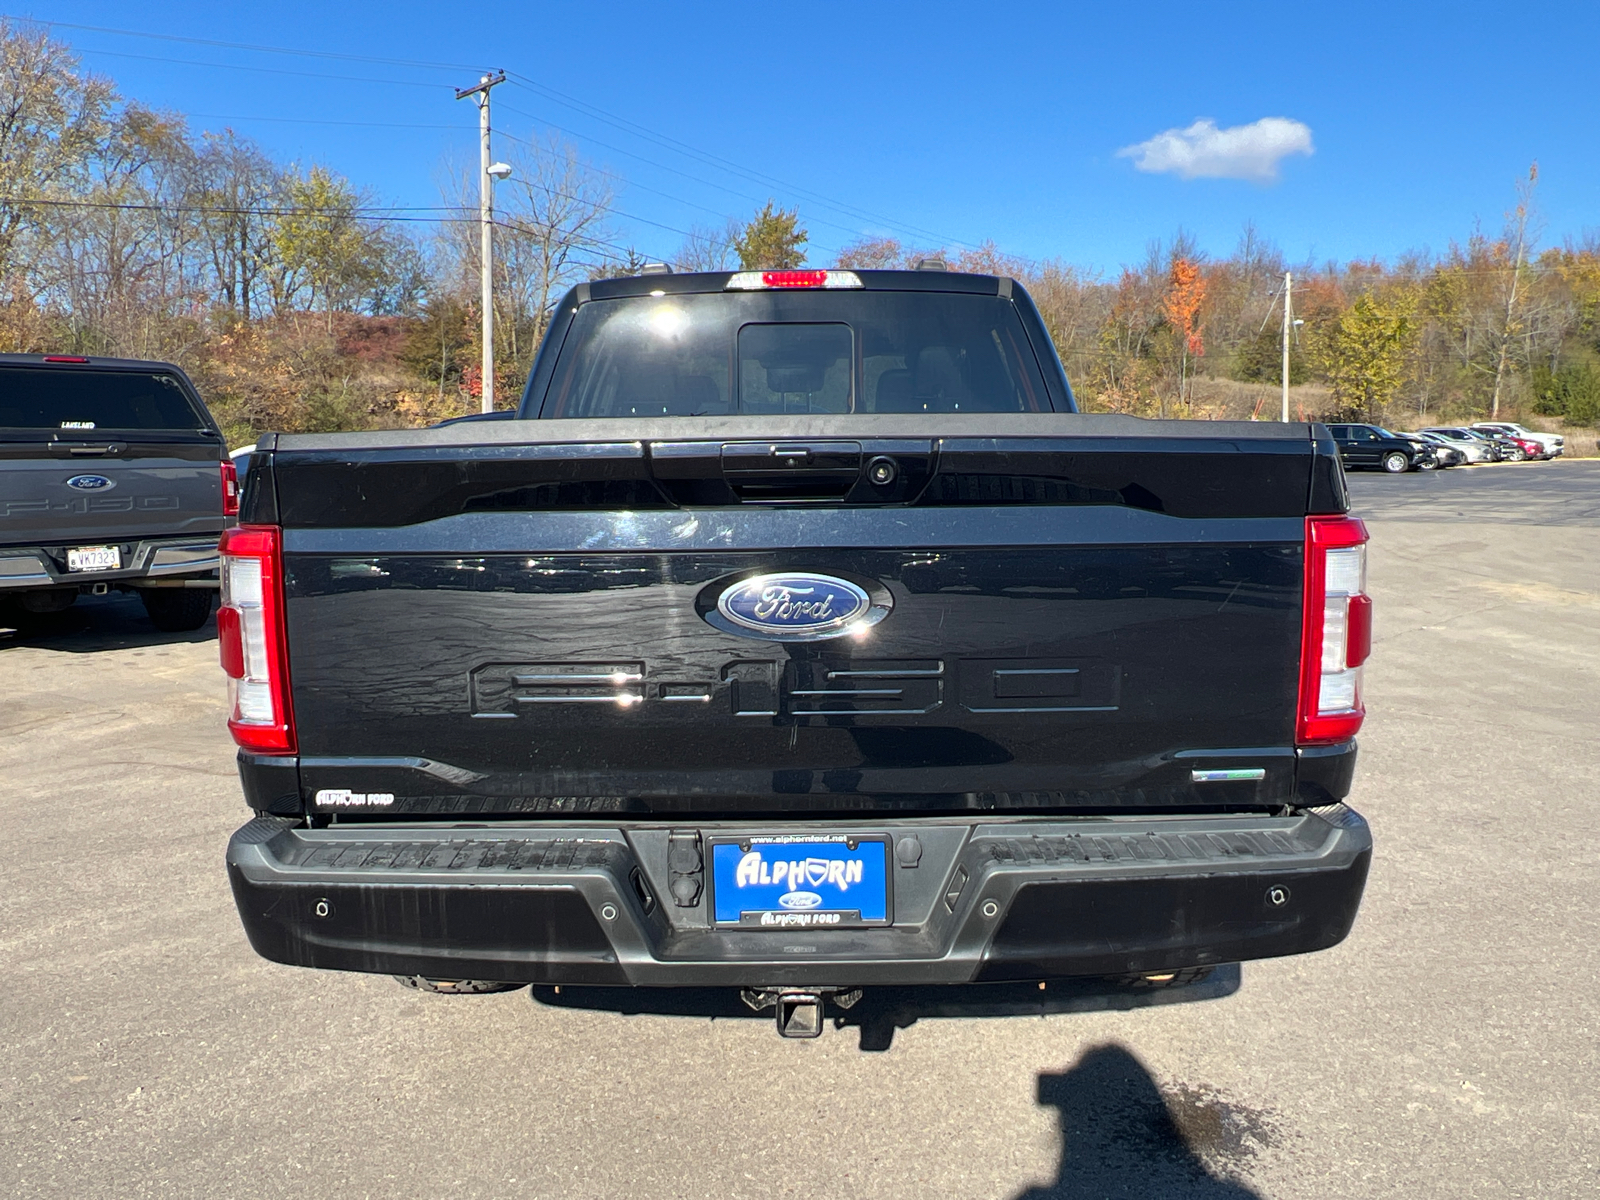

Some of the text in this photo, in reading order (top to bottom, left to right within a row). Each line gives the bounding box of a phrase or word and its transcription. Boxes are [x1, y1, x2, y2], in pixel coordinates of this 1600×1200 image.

[78, 477, 102, 488] Ford
[0, 496, 180, 517] F-150
[78, 551, 116, 566] VK7323
[754, 585, 834, 620] Ford
[469, 656, 1122, 721] F-150
[367, 793, 395, 806] FORD
[749, 834, 848, 844] www.alphornford.net
[812, 913, 841, 925] FORD
